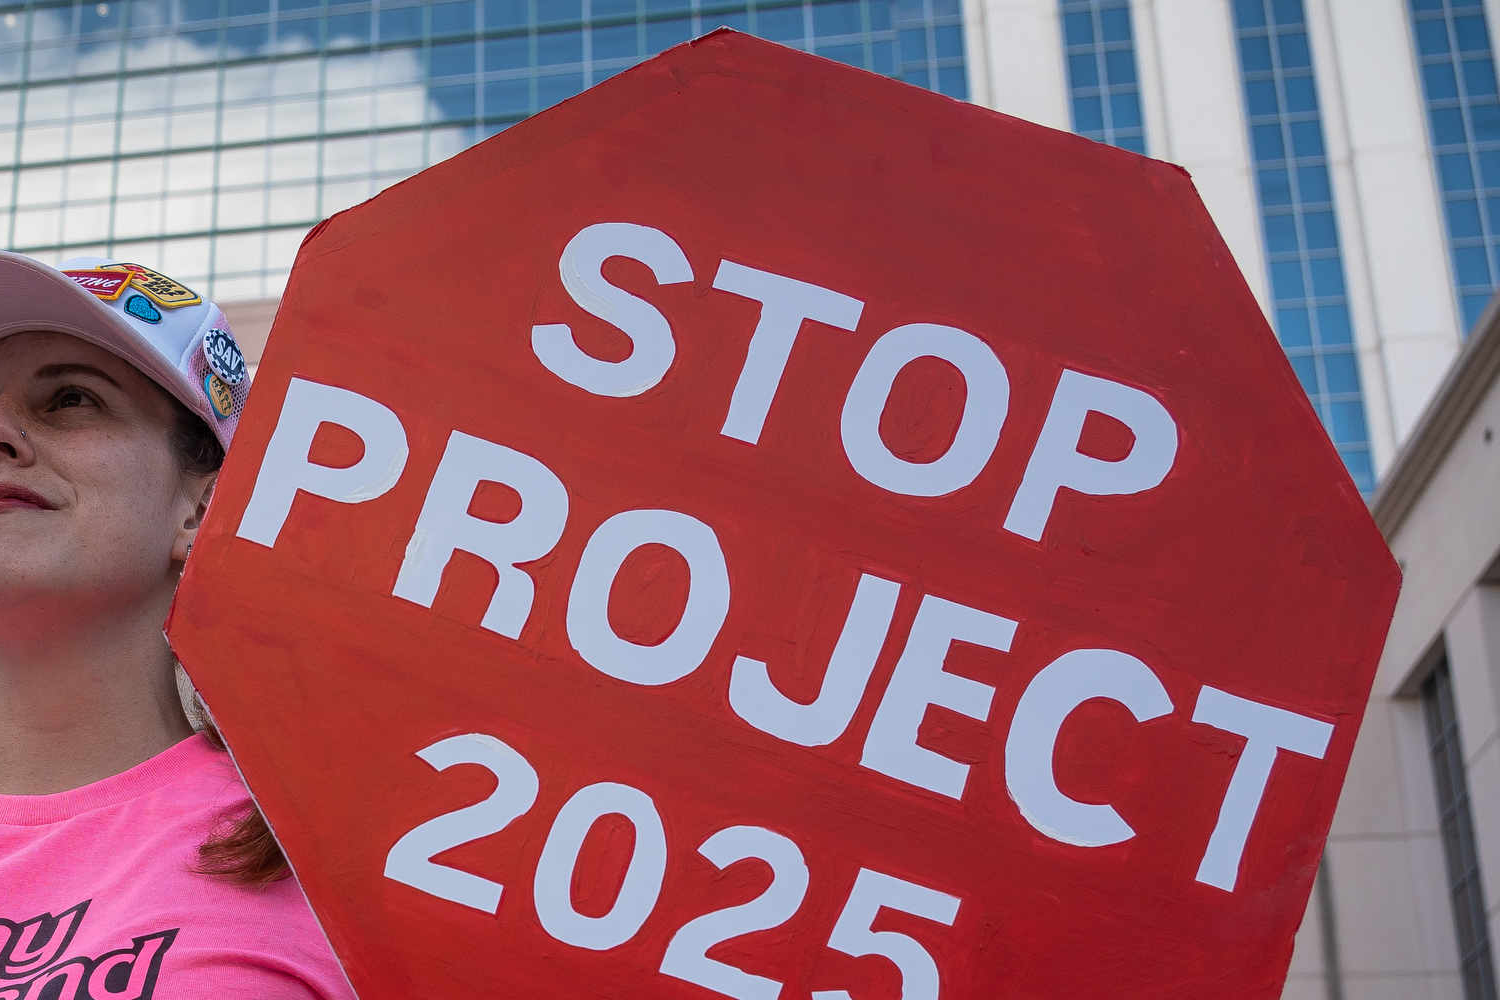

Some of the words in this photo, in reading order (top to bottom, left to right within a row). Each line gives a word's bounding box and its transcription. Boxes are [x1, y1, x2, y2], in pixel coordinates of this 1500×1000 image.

[68, 277, 121, 287] TING
[215, 336, 241, 371] SAV
[532, 222, 1178, 542] STOP
[236, 377, 1335, 893] PROJECT
